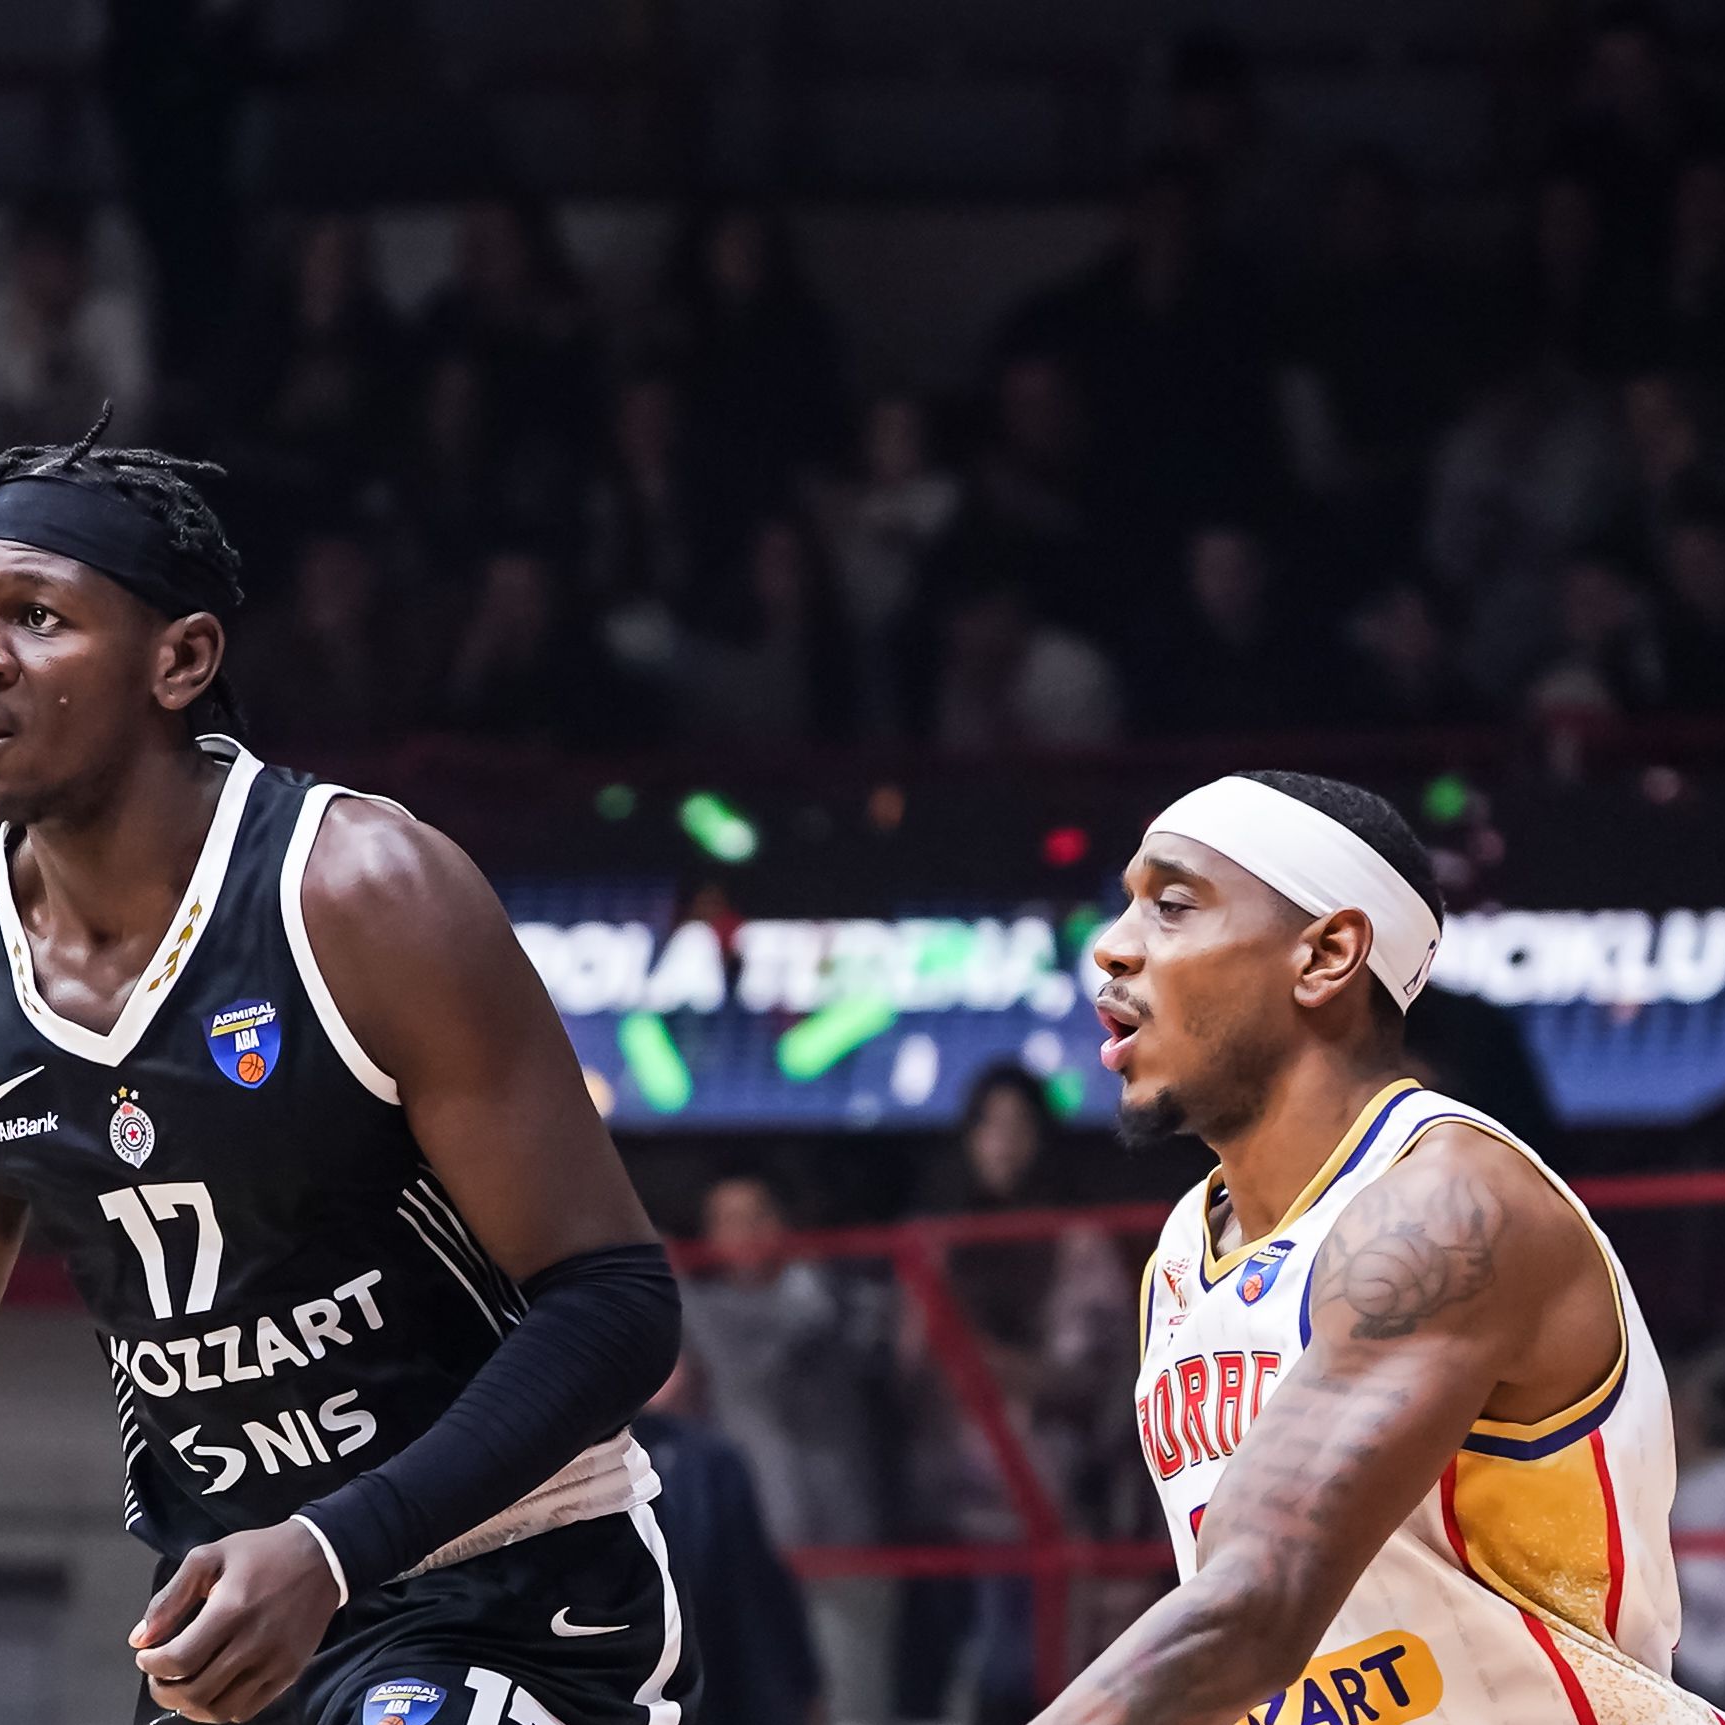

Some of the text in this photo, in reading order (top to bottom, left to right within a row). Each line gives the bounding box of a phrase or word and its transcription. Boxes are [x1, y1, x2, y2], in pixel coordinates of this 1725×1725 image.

[212, 1002, 276, 1028] ADMIRAL
[235, 1028, 260, 1053] ABA
[98, 1181, 224, 1319] 17
[241, 1388, 377, 1475] NIS
[375, 1685, 440, 1699] ADMIRAL
[383, 1700, 411, 1715] ABA
